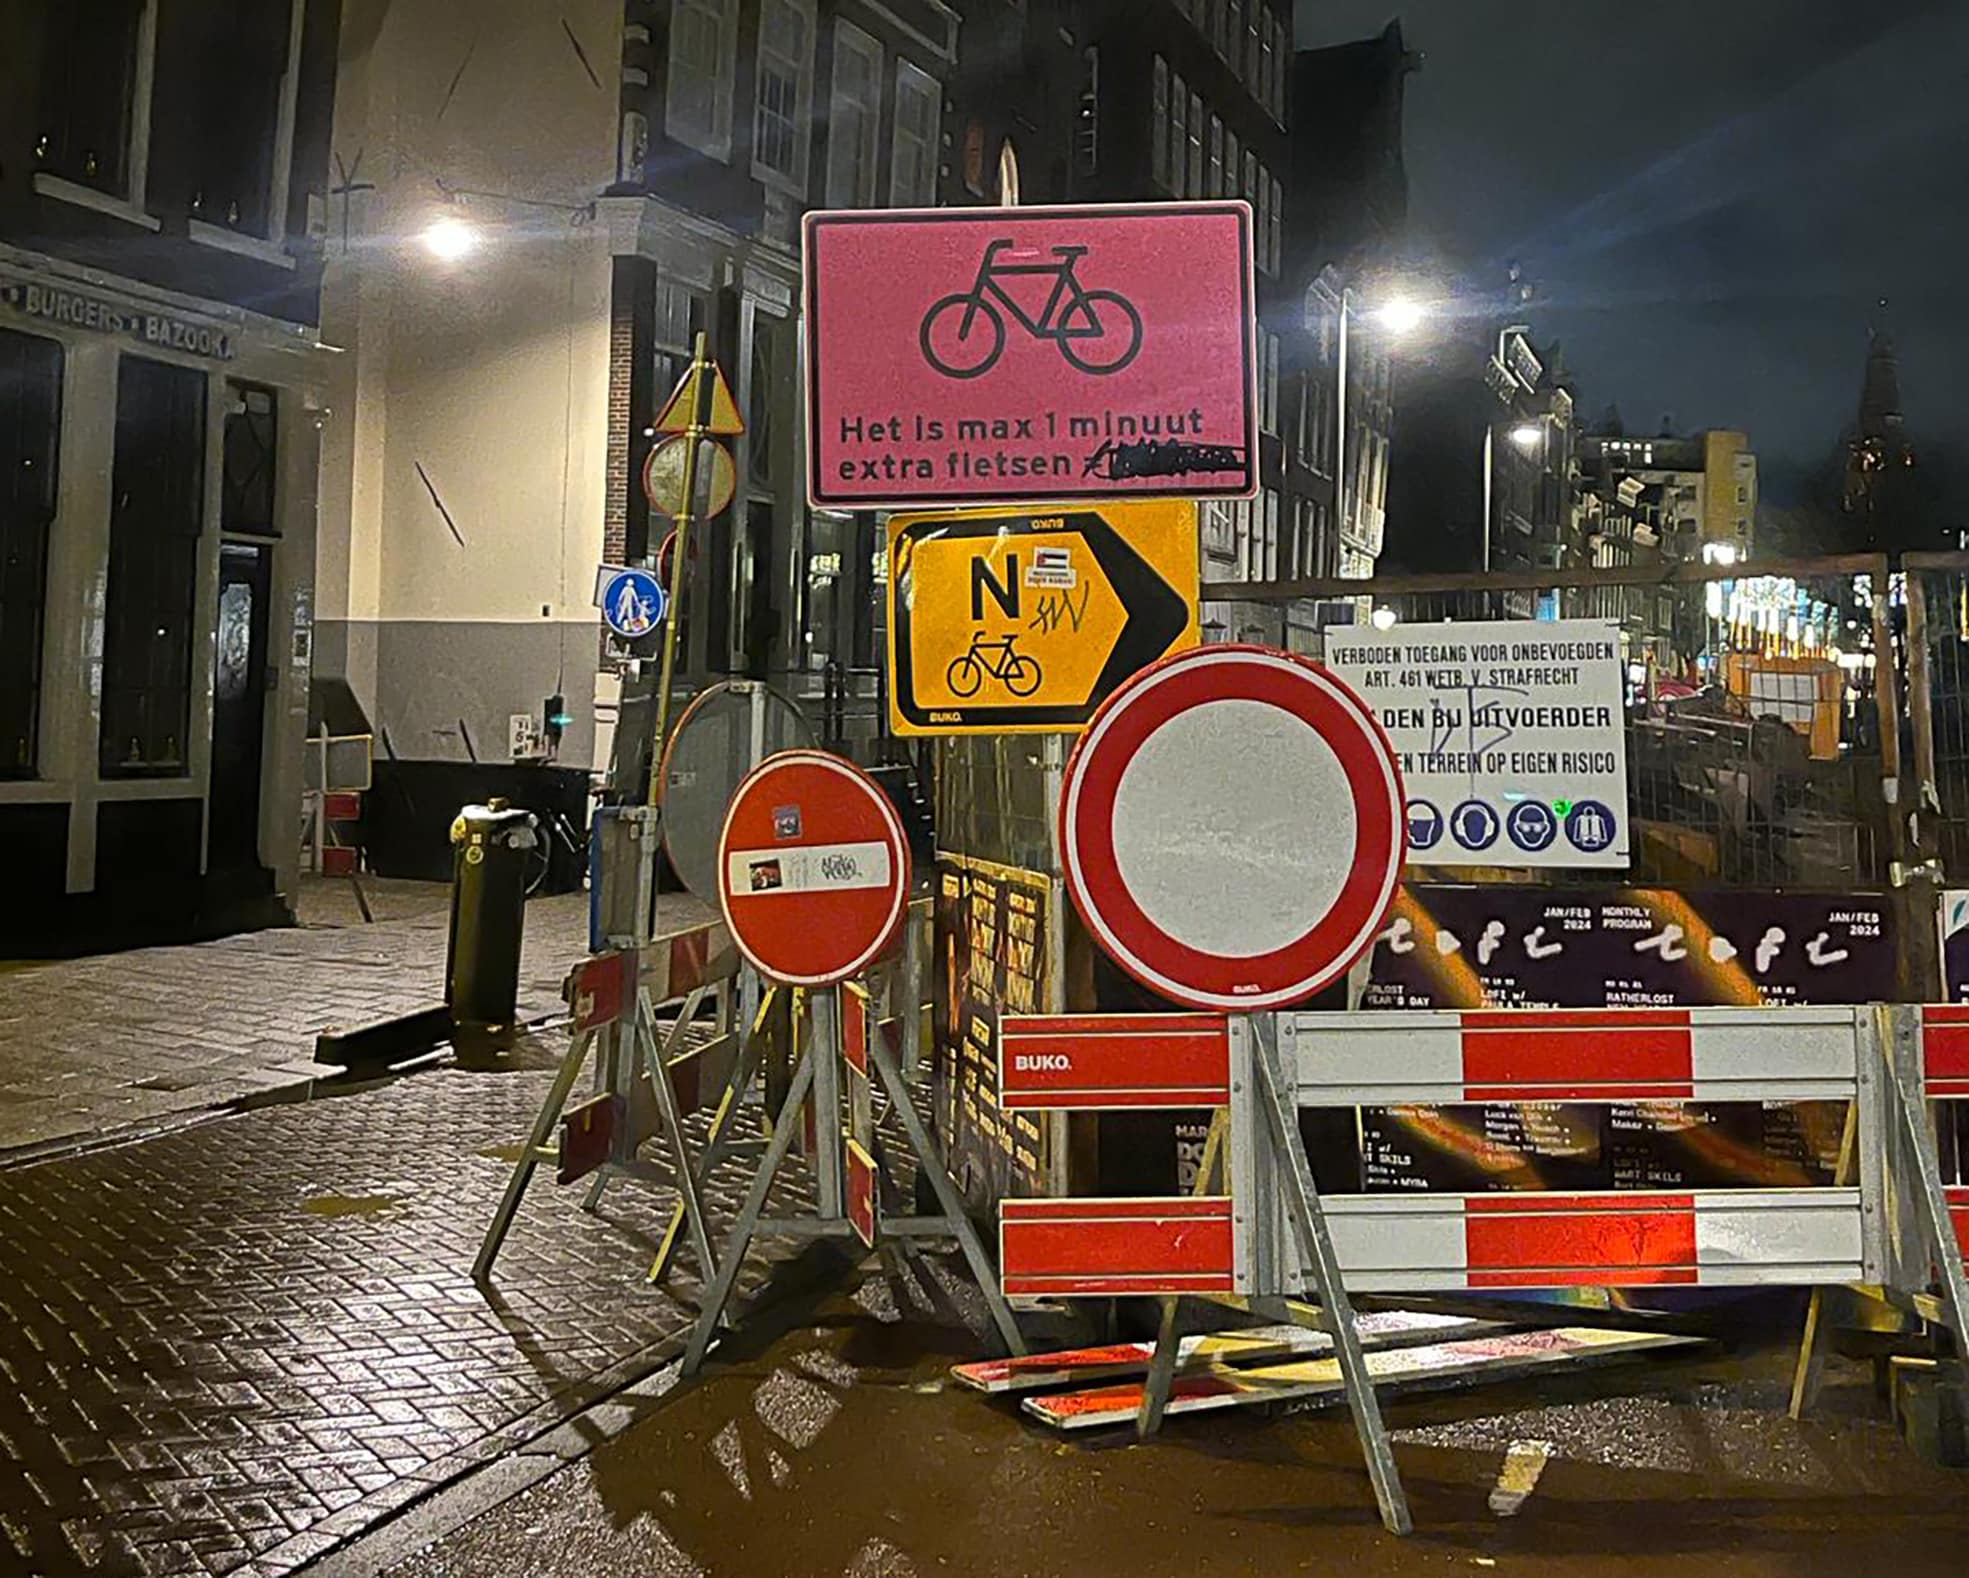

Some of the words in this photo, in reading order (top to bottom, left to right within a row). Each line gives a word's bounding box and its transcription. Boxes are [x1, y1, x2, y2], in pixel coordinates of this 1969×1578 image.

[26, 285, 124, 330] BURGERS
[841, 416, 902, 443] Het
[957, 418, 1033, 441] max
[1045, 411, 1055, 438] 1
[1070, 409, 1203, 437] minuut
[839, 454, 934, 480] extra
[947, 451, 1071, 478] fietsen
[971, 553, 1020, 621] N
[1332, 647, 1401, 664] VERBODEN
[1405, 645, 1467, 662] TOEGANG
[1471, 644, 1508, 662] VOOR
[1512, 643, 1614, 660] ONBEVOEGDEN
[1365, 670, 1396, 688] ART.
[1399, 670, 1422, 687] 461
[1489, 667, 1579, 685] STRAFRECHT
[1471, 707, 1611, 728] UITVOERDER
[1418, 752, 1482, 774] TERREIN
[1487, 752, 1506, 774] OP
[1511, 752, 1557, 774] EIGEN
[1562, 752, 1616, 774] RISICO
[1563, 919, 1592, 930] 2024
[1829, 912, 1880, 923] JAN/FEB
[1849, 925, 1880, 936] 2024
